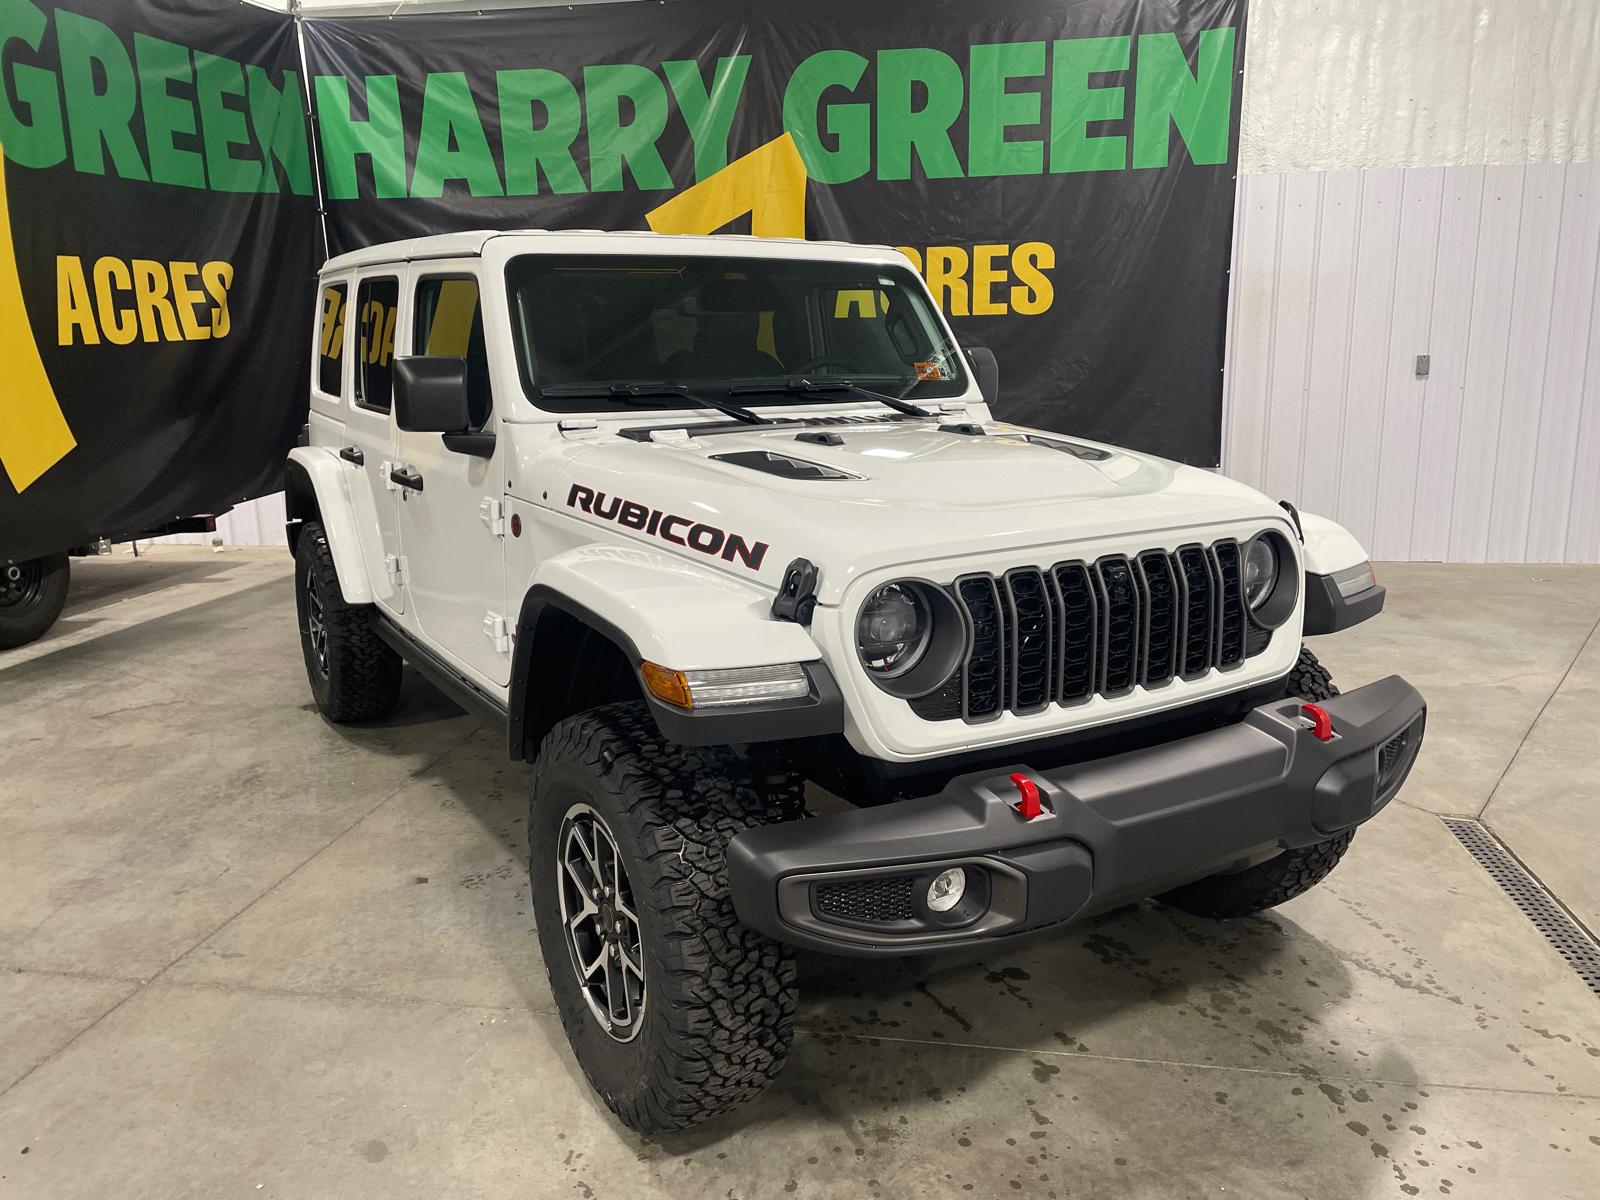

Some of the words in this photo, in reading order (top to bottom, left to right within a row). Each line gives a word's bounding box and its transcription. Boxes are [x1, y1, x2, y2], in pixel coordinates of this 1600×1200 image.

[0, 0, 313, 196] GREEN
[314, 54, 753, 199] HARRY
[782, 27, 1236, 184] GREEN
[56, 255, 234, 346] ACRES
[567, 483, 769, 570] RUBICON
